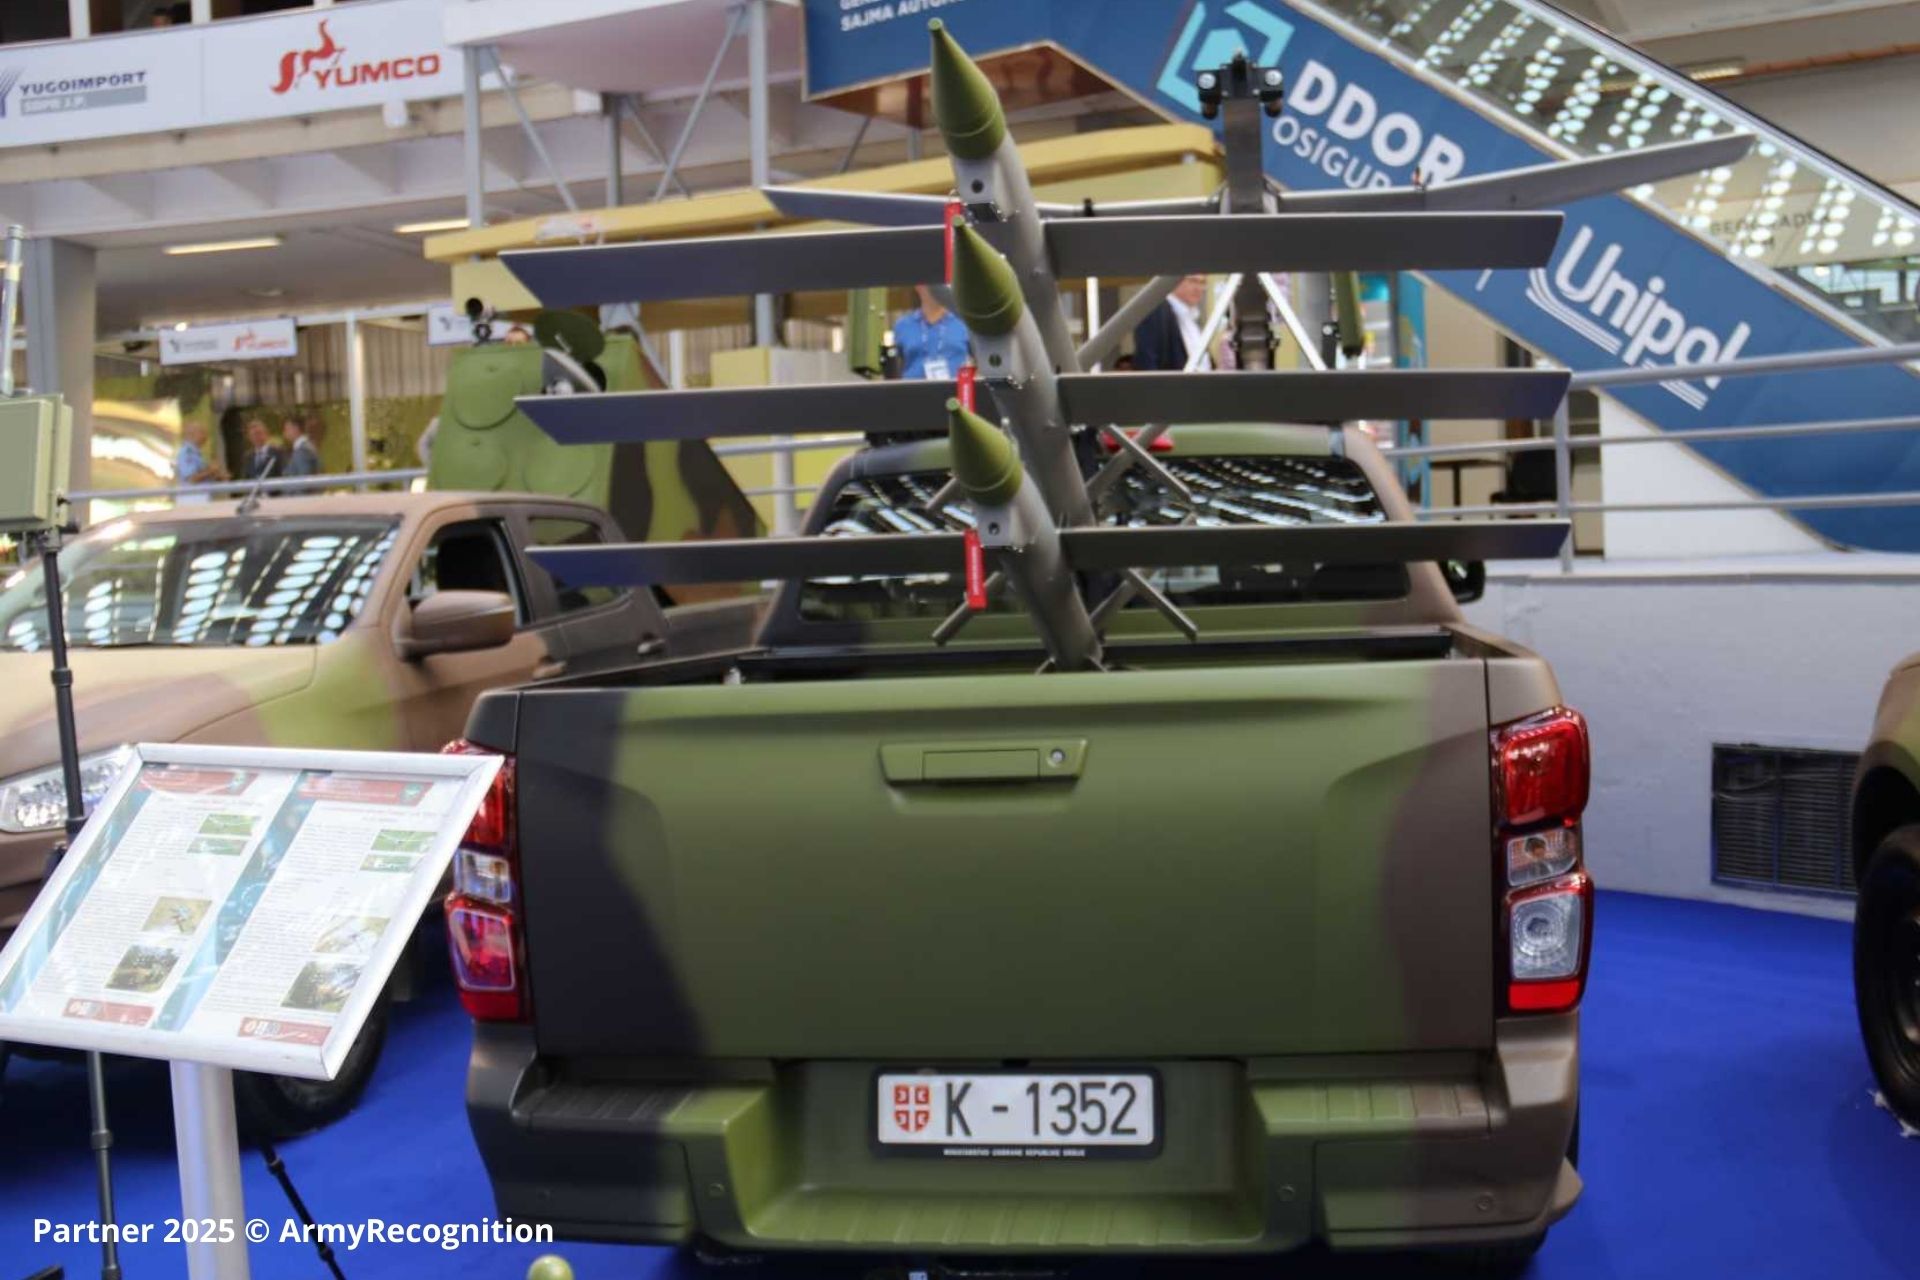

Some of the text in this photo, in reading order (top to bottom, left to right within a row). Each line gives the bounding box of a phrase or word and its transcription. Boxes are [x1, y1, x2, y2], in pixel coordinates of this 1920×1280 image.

[20, 71, 147, 96] YUGOIMPORT
[314, 54, 439, 90] YUMCO
[1287, 59, 1465, 188] DDOR
[1555, 225, 1751, 390] Unipol
[945, 1082, 972, 1136] K
[1026, 1082, 1138, 1136] 1352
